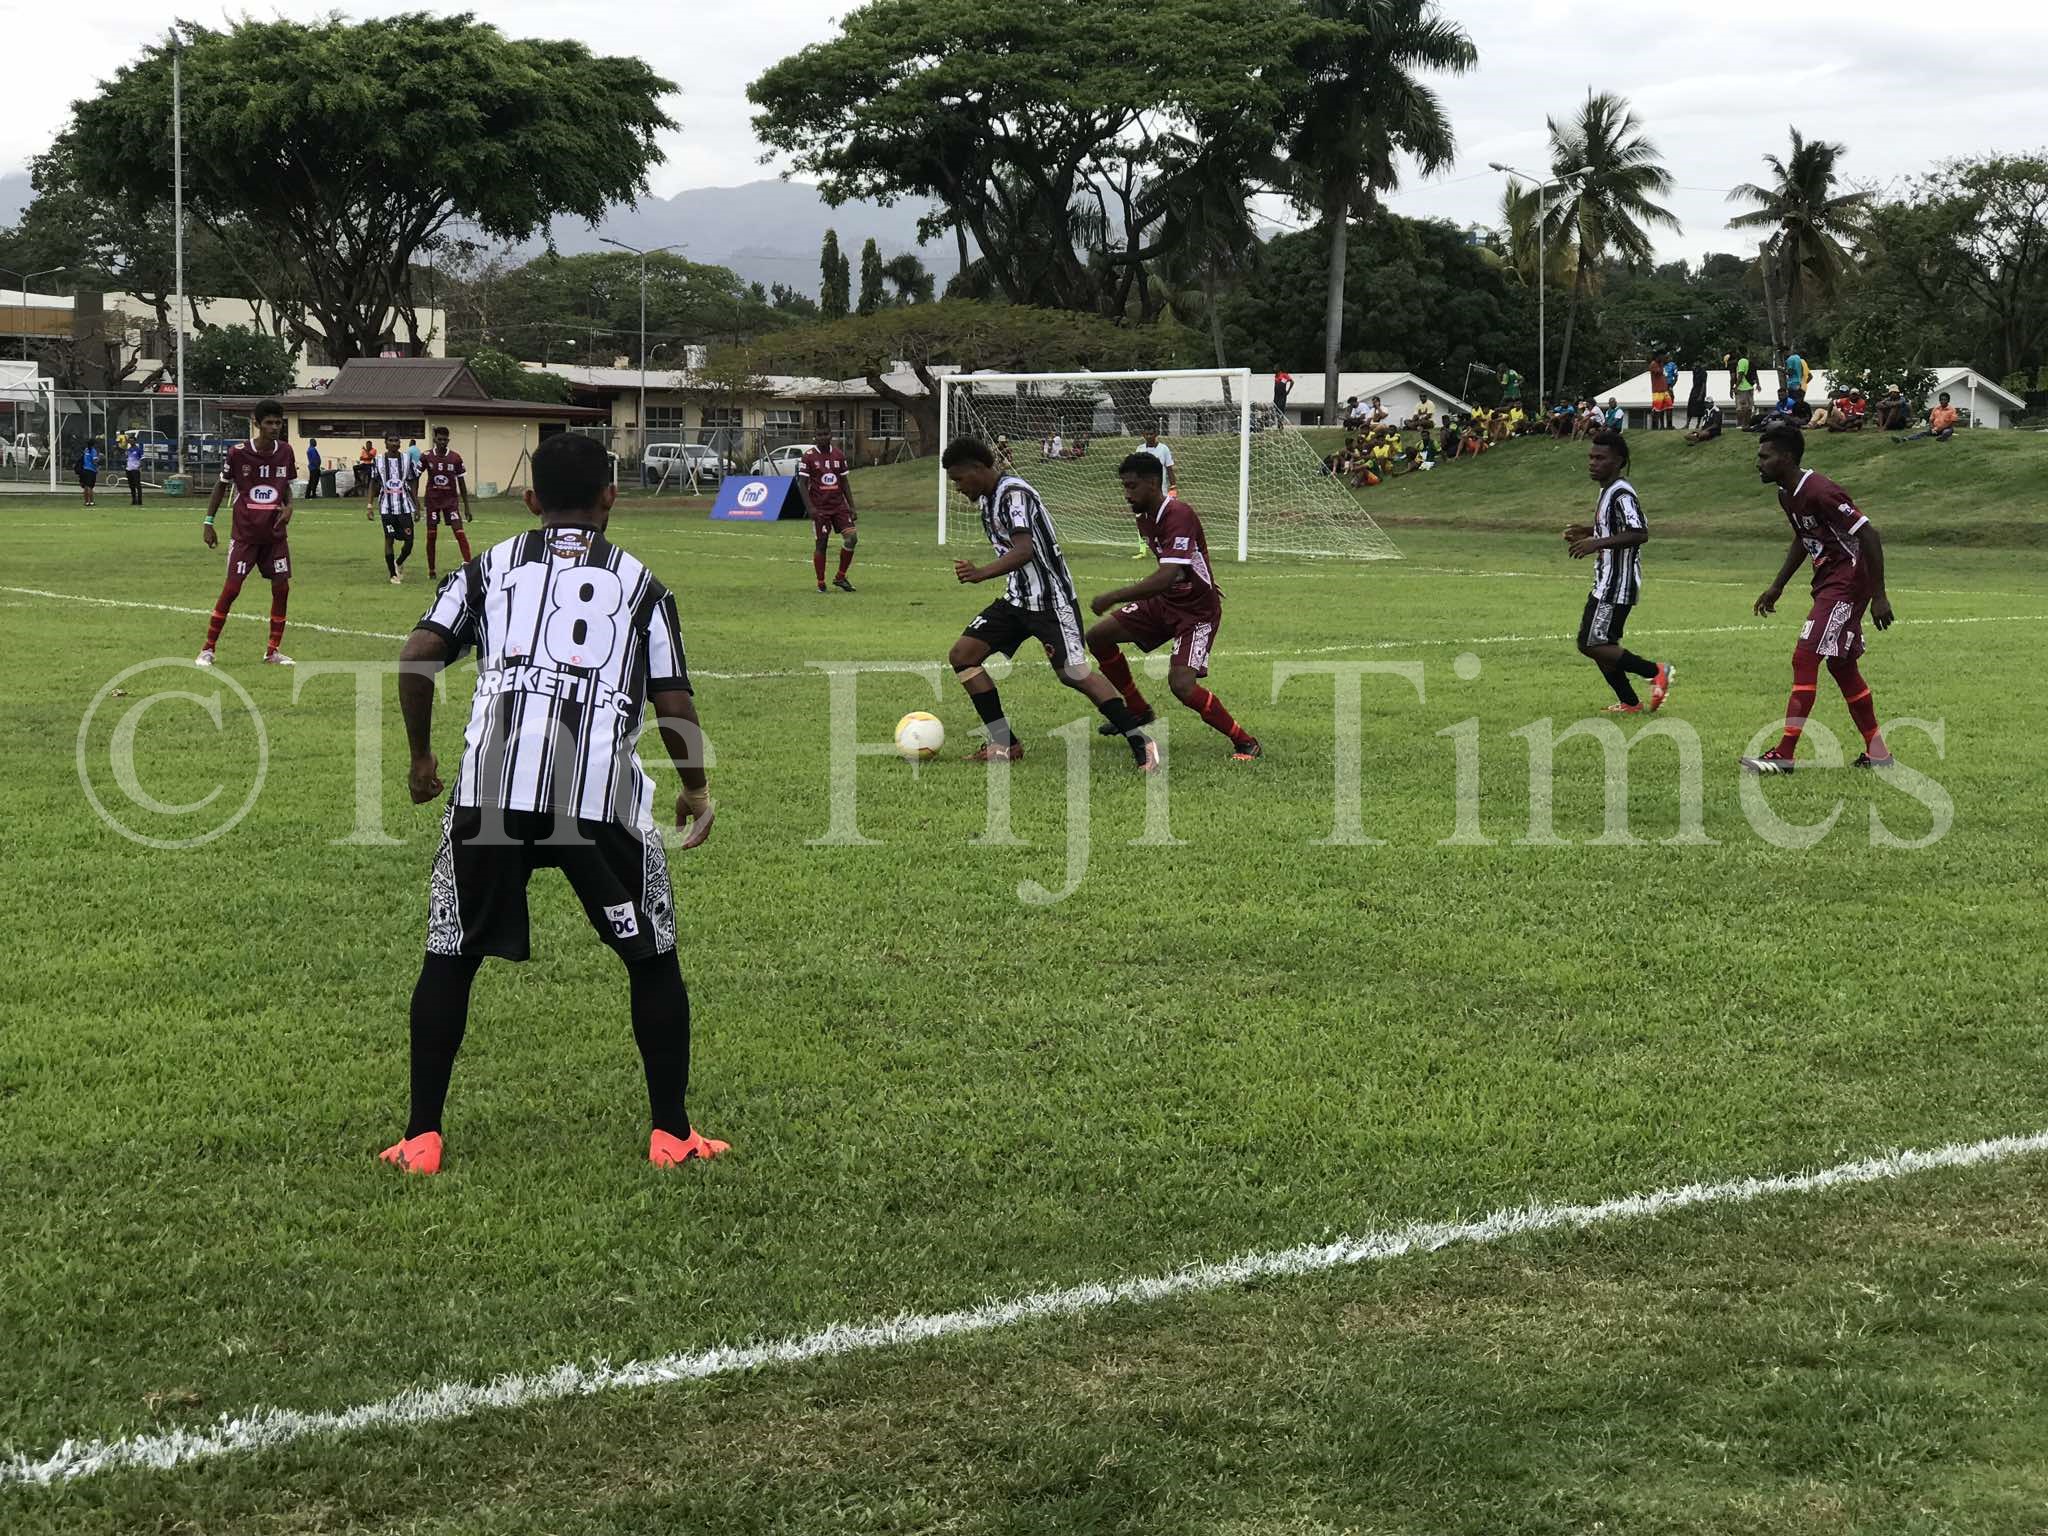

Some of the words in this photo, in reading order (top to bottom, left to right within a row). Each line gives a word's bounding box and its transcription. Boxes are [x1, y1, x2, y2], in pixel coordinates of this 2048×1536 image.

[258, 464, 270, 479] 11
[254, 488, 273, 500] fmf
[431, 511, 438, 521] 5
[236, 560, 247, 575] 11
[500, 560, 624, 670] 18
[1121, 602, 1139, 615] 3
[593, 679, 633, 719] FC
[612, 917, 635, 935] DC
